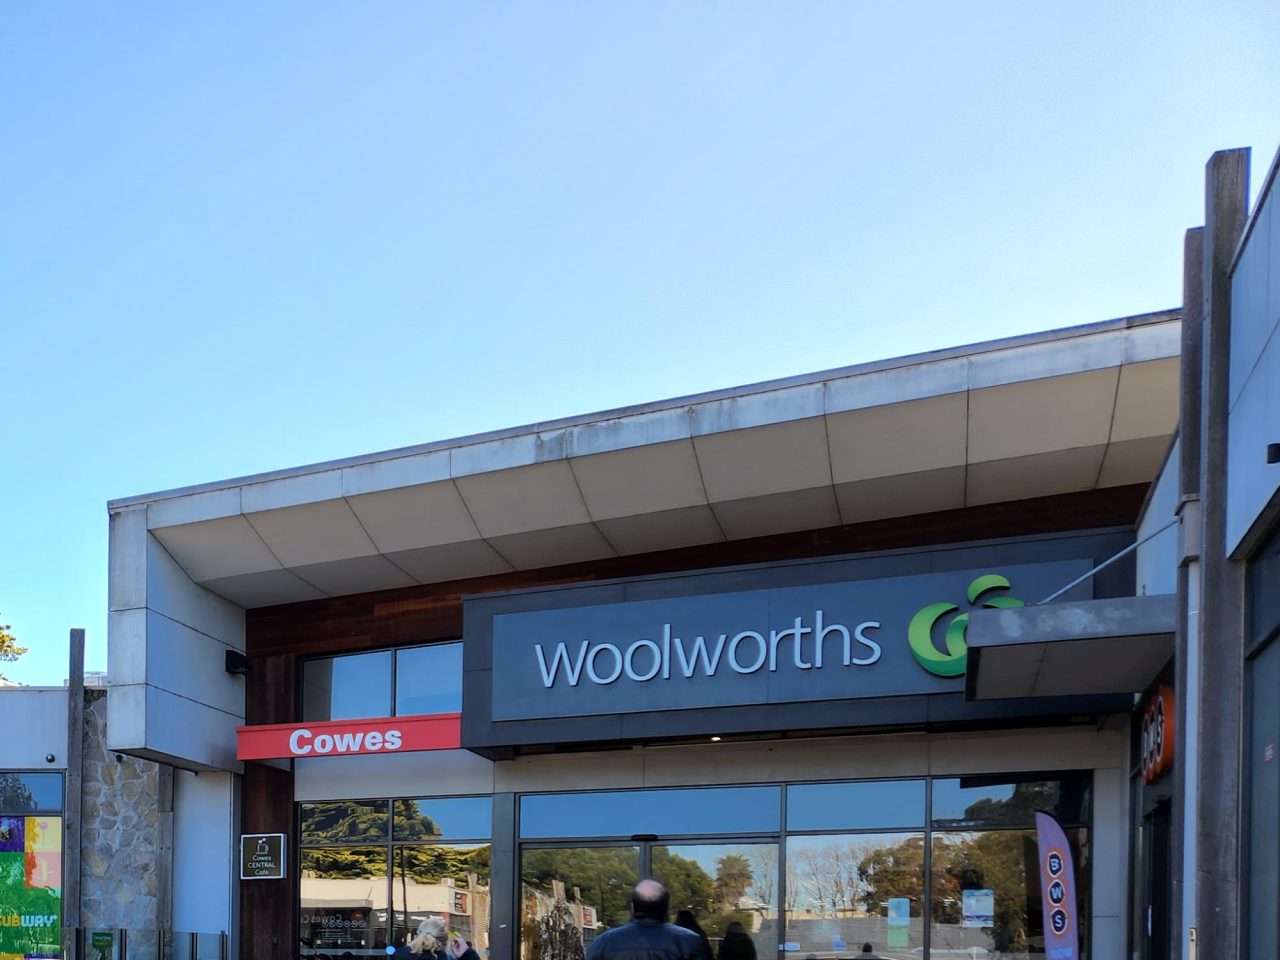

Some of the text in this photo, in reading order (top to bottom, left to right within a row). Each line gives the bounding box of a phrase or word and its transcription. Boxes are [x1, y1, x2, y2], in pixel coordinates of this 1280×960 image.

[289, 728, 403, 755] Cowes
[252, 854, 272, 862] Cowes
[248, 861, 276, 869] CENTRAL
